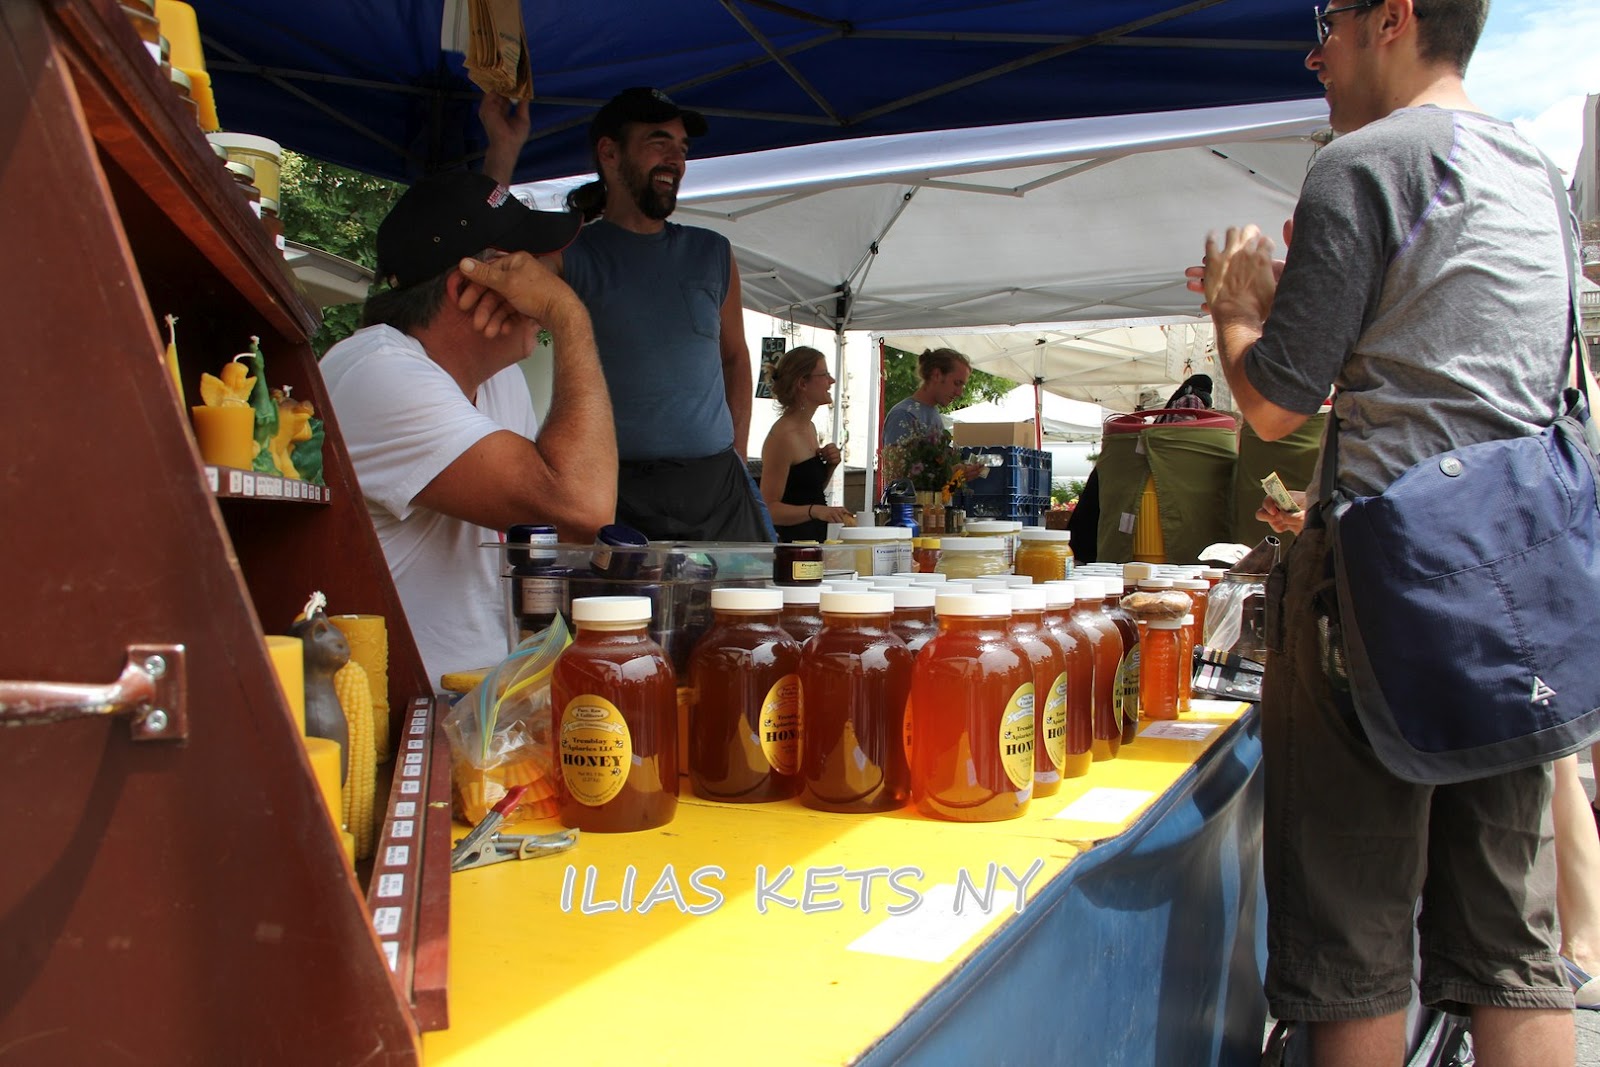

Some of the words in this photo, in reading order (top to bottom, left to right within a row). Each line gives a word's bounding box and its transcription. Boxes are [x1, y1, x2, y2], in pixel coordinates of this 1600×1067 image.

[572, 737, 607, 745] Tremblay
[568, 744, 597, 752] Apiaries
[599, 744, 613, 752] LLC
[563, 753, 623, 768] HONEY
